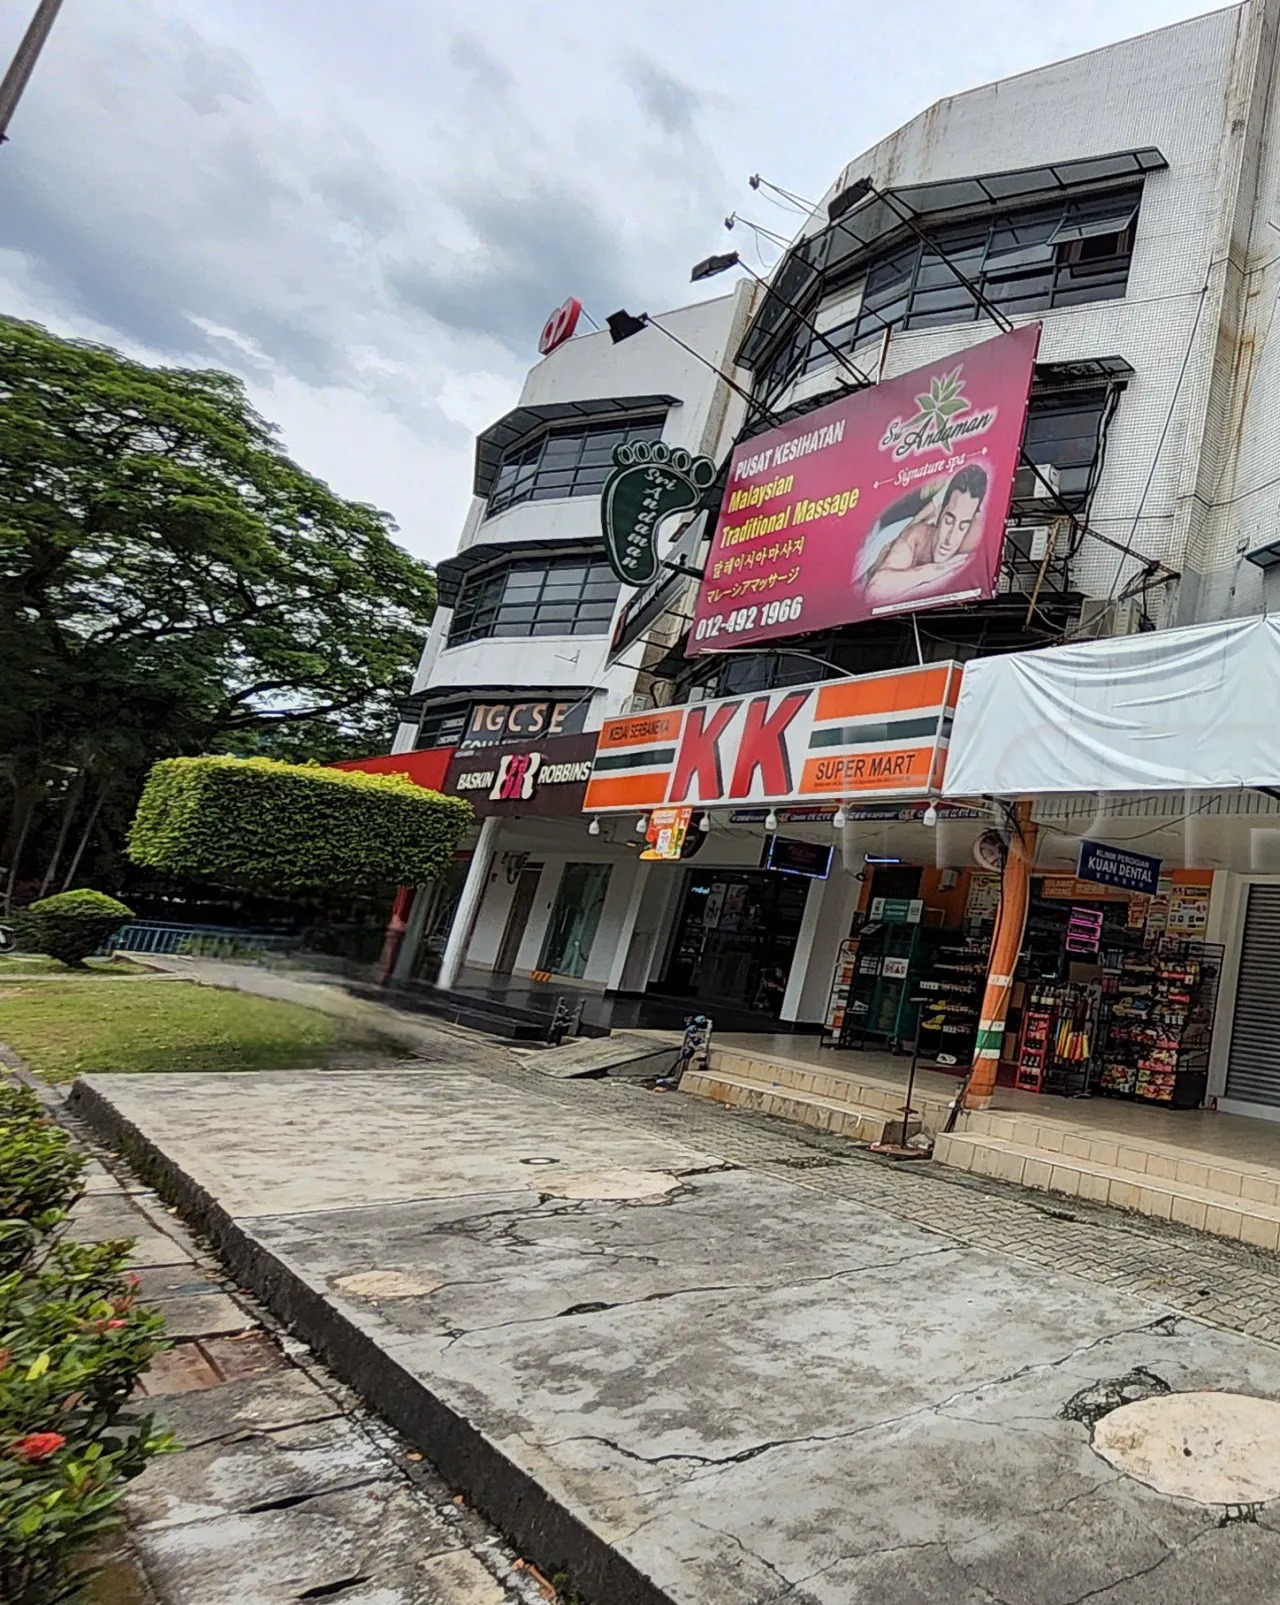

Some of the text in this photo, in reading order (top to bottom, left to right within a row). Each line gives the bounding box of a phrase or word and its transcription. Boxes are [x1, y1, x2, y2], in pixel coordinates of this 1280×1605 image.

[733, 419, 846, 482] PUSAT KESIHATAN
[895, 412, 993, 457] Andaman
[644, 468, 678, 491] Sri
[893, 453, 966, 487] Signature spa
[727, 474, 795, 514] Malaysian
[621, 487, 663, 569] Andaman
[720, 488, 860, 549] Traditional Massage
[706, 566, 801, 604] マレーシアマッサージ
[695, 596, 804, 641] 012-492 1966
[472, 703, 569, 733] IGCSE
[669, 688, 813, 803] KK
[456, 771, 495, 790] BASKIN
[537, 761, 592, 784] ROBBINS
[815, 754, 916, 781] SUPER MART
[1088, 856, 1117, 875] KUAN
[1119, 864, 1153, 883] DENTAL
